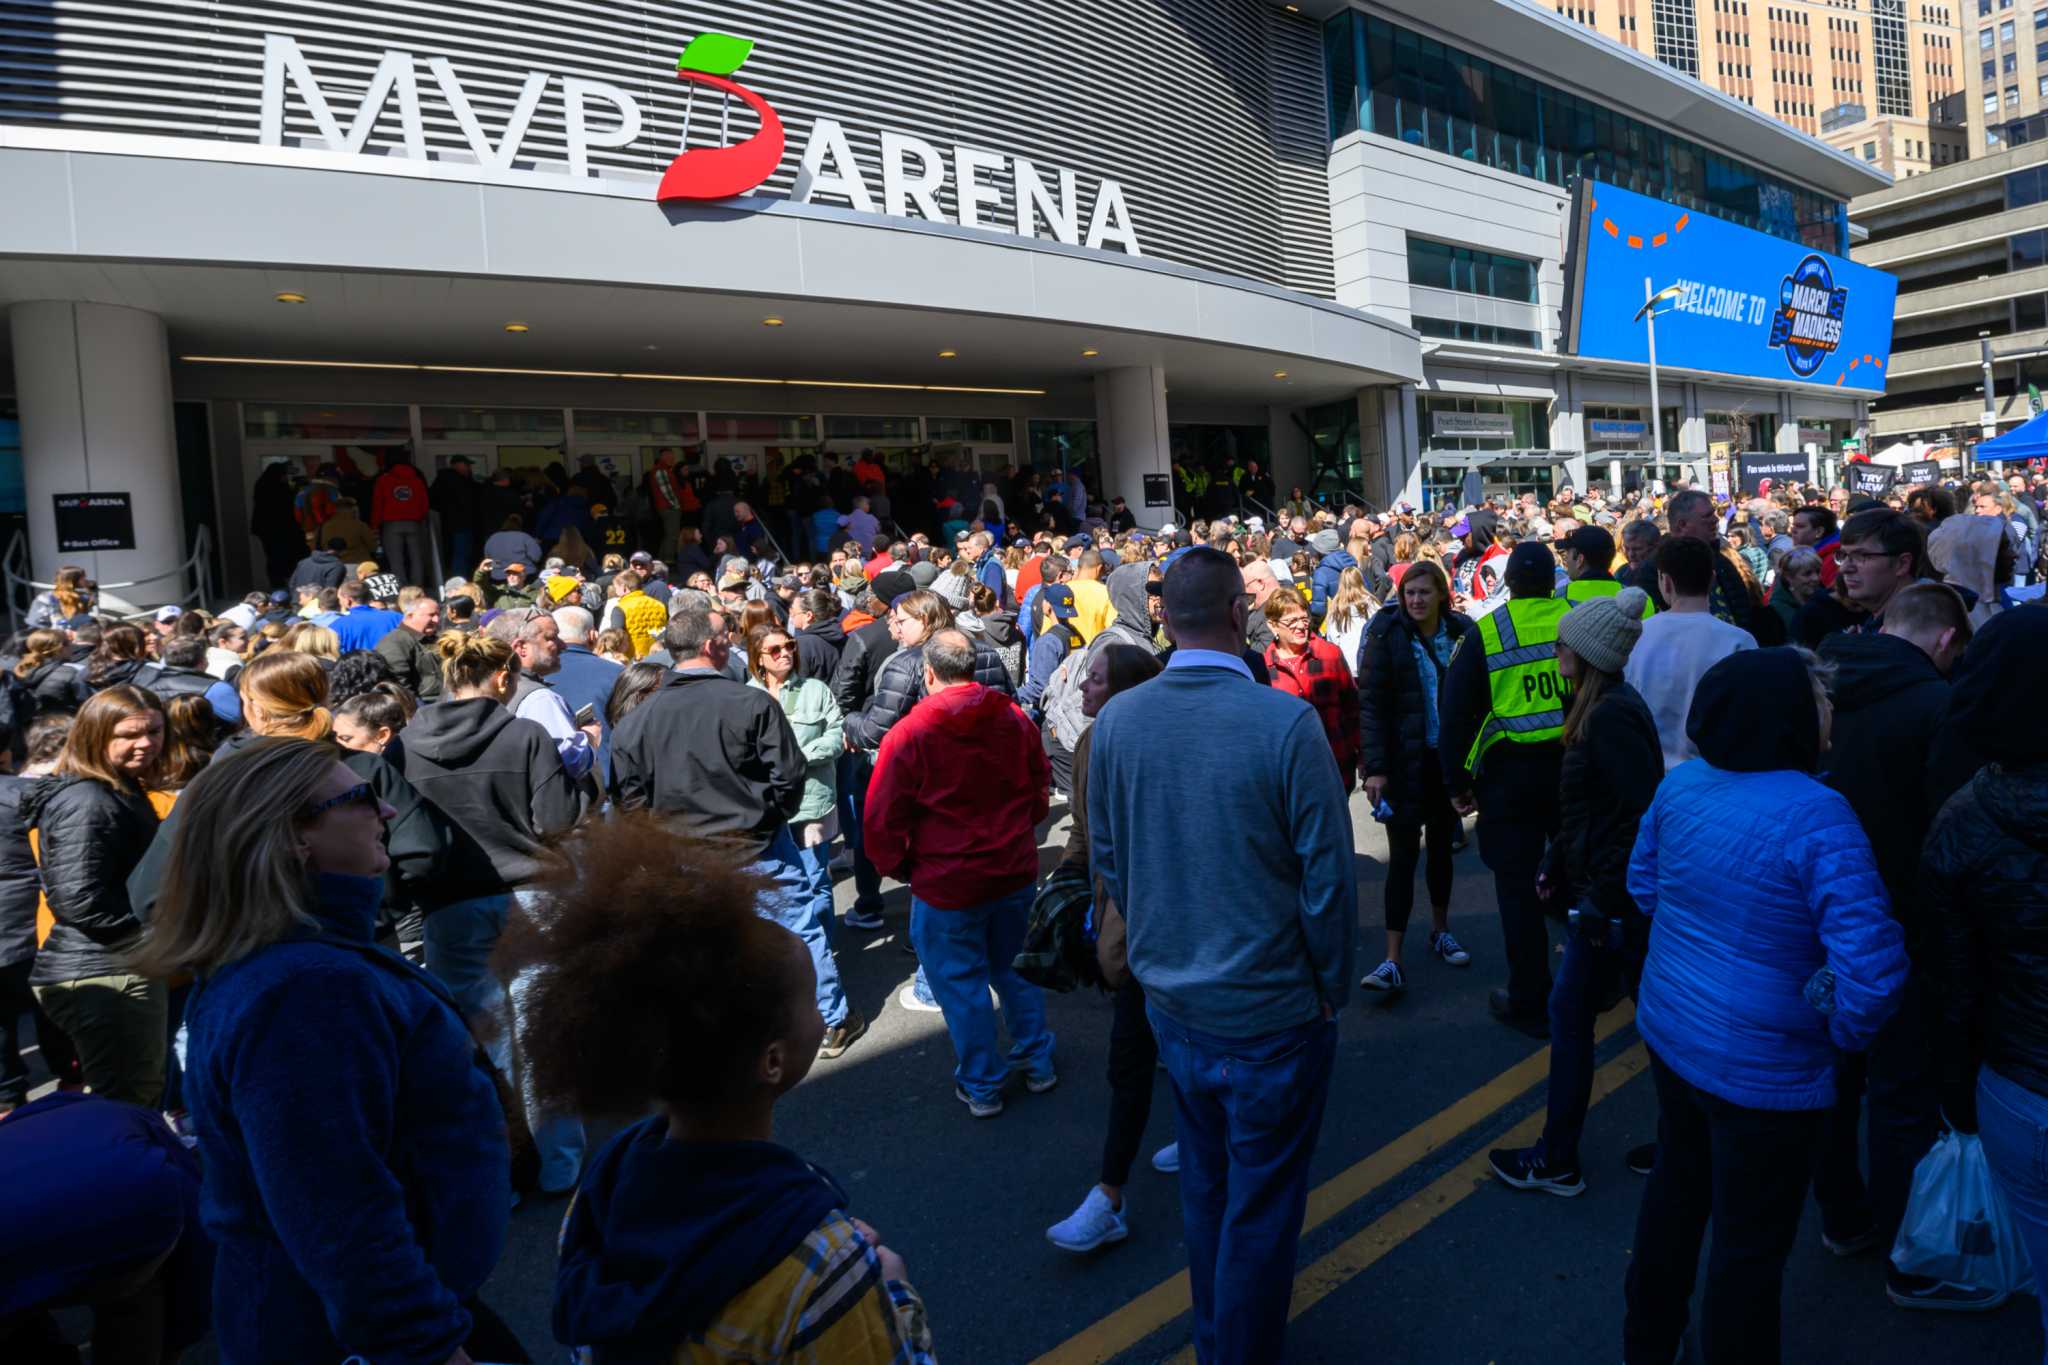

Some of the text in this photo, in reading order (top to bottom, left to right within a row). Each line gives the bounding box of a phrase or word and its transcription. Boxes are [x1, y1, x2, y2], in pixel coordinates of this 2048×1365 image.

[259, 33, 1142, 257] MVP ARENA
[1673, 278, 1767, 326] WELCOME TO
[1791, 284, 1830, 316] MARCH
[1792, 311, 1842, 343] MADNESS
[1747, 464, 1757, 474] Fan
[1911, 468, 1929, 476] TRY
[1861, 473, 1884, 483] TRY
[1911, 474, 1932, 483] NEW
[1857, 481, 1884, 492] NEW
[88, 498, 125, 507] ARENA
[606, 529, 625, 545] 22
